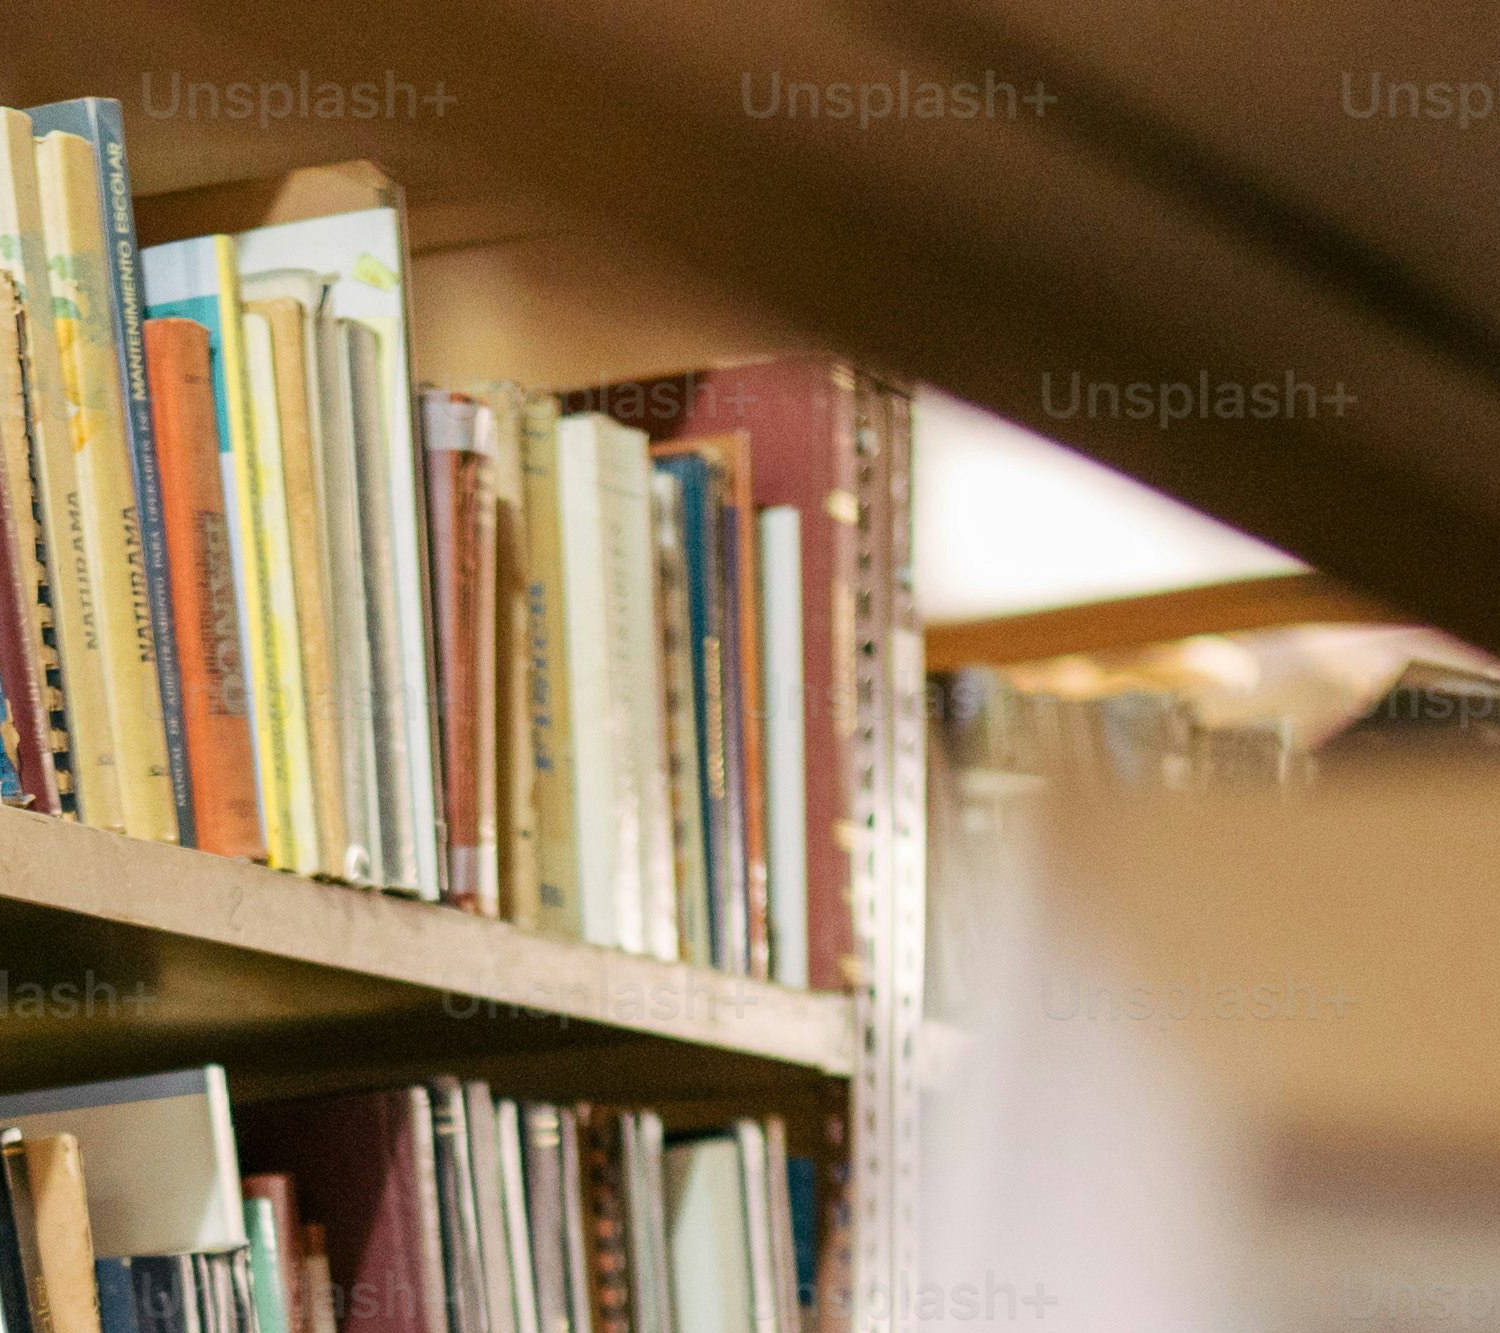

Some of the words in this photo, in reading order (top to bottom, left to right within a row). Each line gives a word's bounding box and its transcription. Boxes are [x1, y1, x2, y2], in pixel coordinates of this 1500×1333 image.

[105, 142, 130, 235] ESCOLAR
[115, 241, 147, 402] MANTENIMIENTO
[63, 489, 99, 651] NATURAMA
[118, 506, 156, 663] NATURAMA
